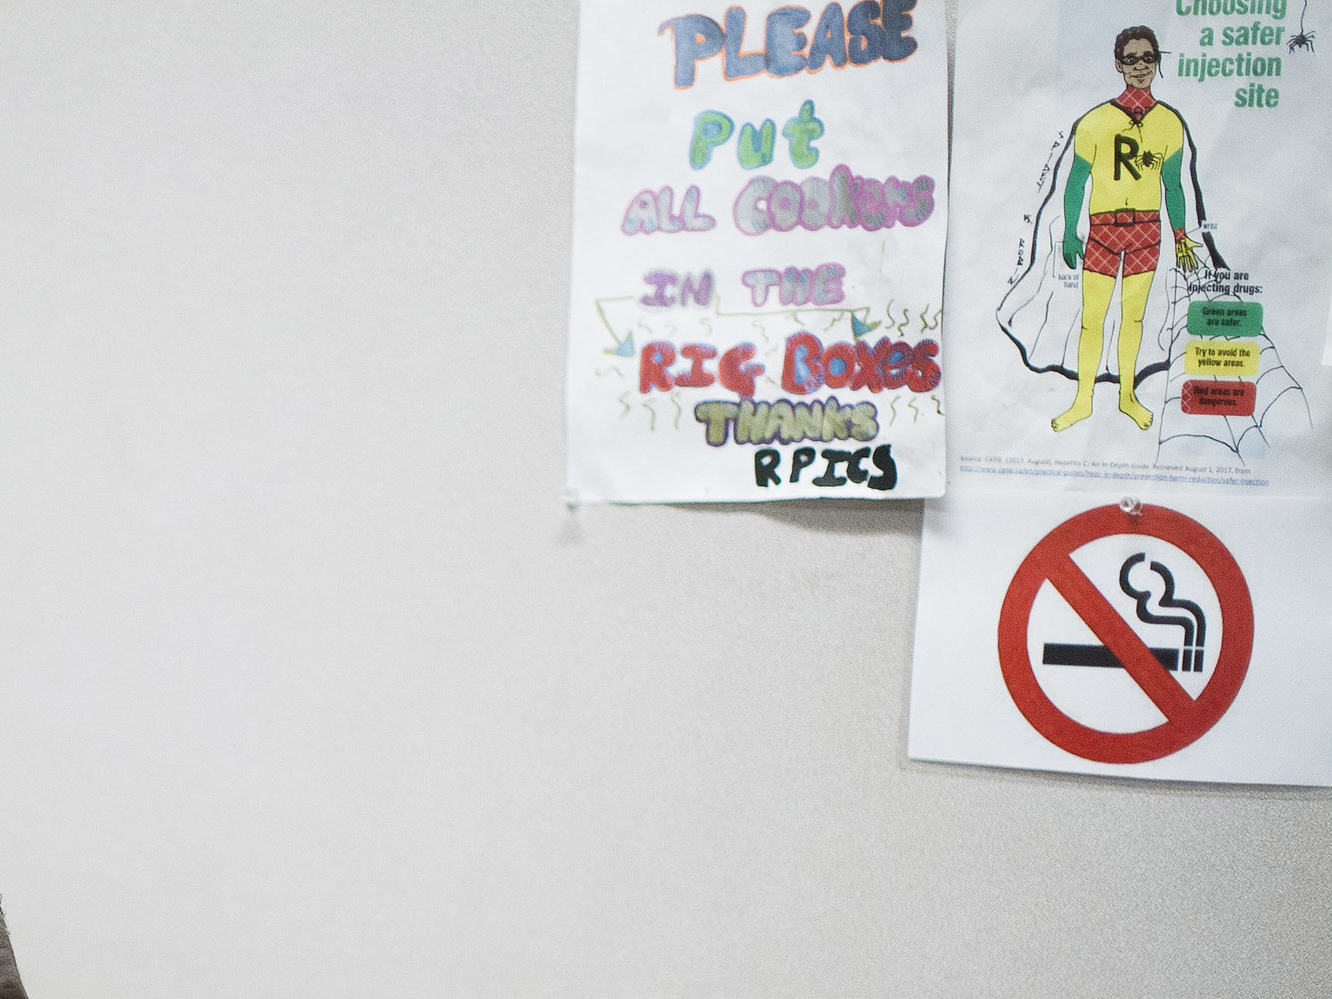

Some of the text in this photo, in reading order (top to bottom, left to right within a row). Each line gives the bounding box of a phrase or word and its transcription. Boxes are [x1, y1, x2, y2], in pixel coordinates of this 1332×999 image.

[1176, 0, 1287, 20] Choosing
[658, 0, 918, 89] PLEASE
[1199, 21, 1285, 46] a safer
[1177, 52, 1282, 82] injection
[1234, 82, 1279, 108] site
[689, 99, 825, 170] Put
[1113, 133, 1141, 182] R
[621, 184, 716, 236] ALL
[639, 262, 846, 307] IN THE
[1215, 272, 1230, 283] you
[1233, 272, 1249, 280] are
[1234, 283, 1263, 295] drugs:
[1202, 306, 1225, 316] Green
[1195, 347, 1251, 357] Try to avoid the
[1198, 358, 1222, 367] yellow
[639, 341, 765, 400] RIG
[1194, 386, 1209, 395] Red
[1233, 388, 1245, 396] are
